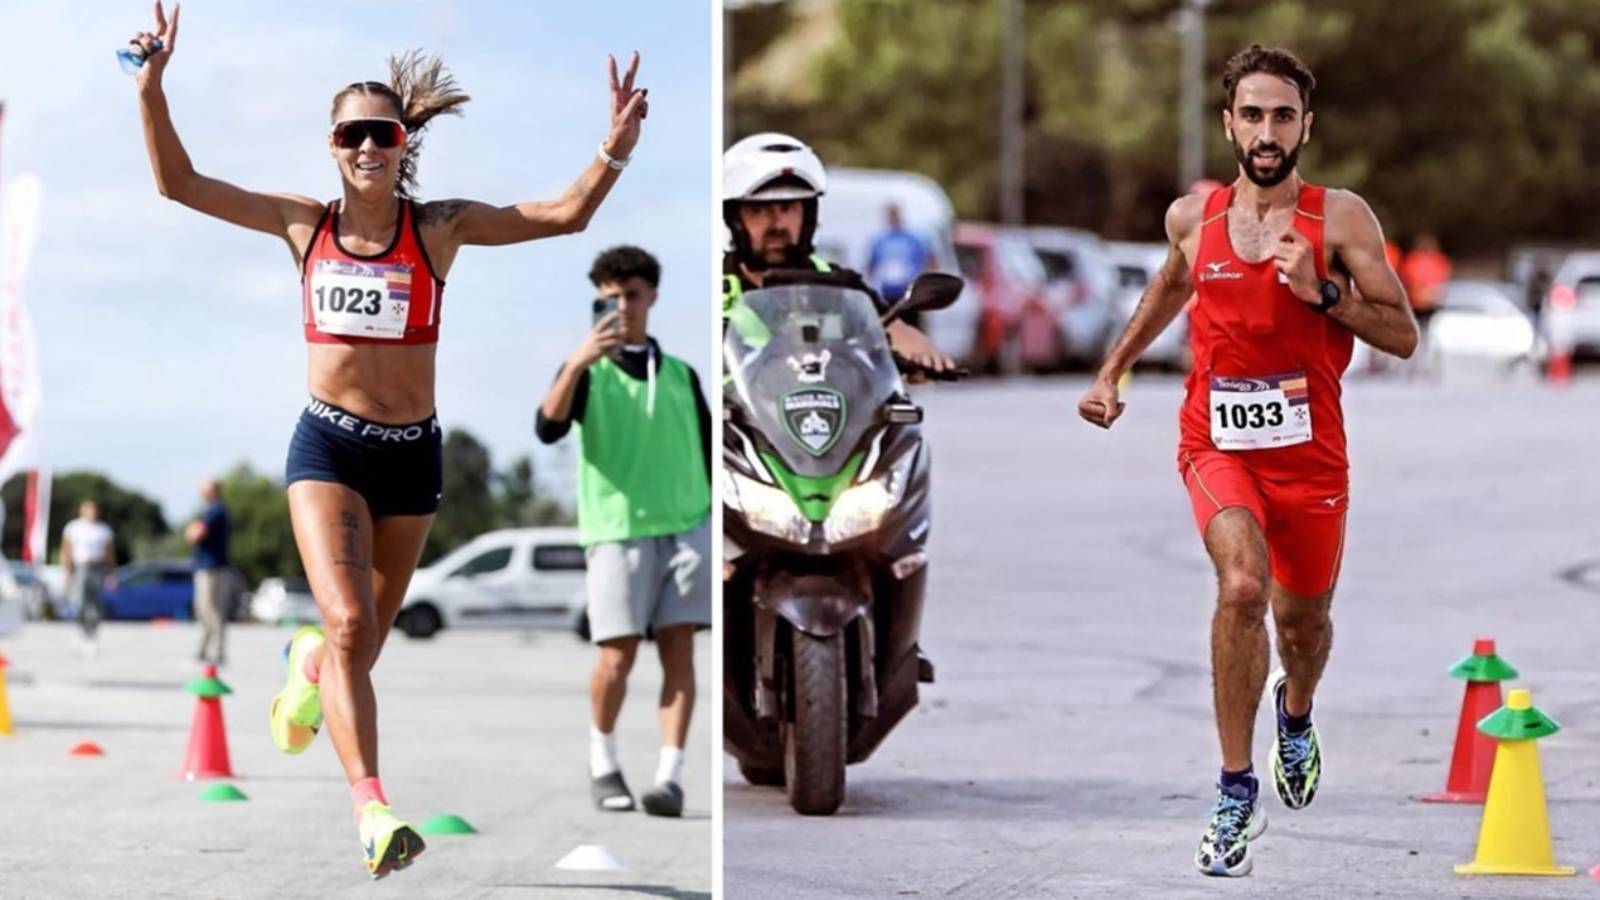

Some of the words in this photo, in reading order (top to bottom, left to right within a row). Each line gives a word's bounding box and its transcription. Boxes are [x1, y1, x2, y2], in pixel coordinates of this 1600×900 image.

[315, 286, 382, 316] 1023
[1215, 402, 1284, 430] 1033
[361, 424, 422, 442] PRO
